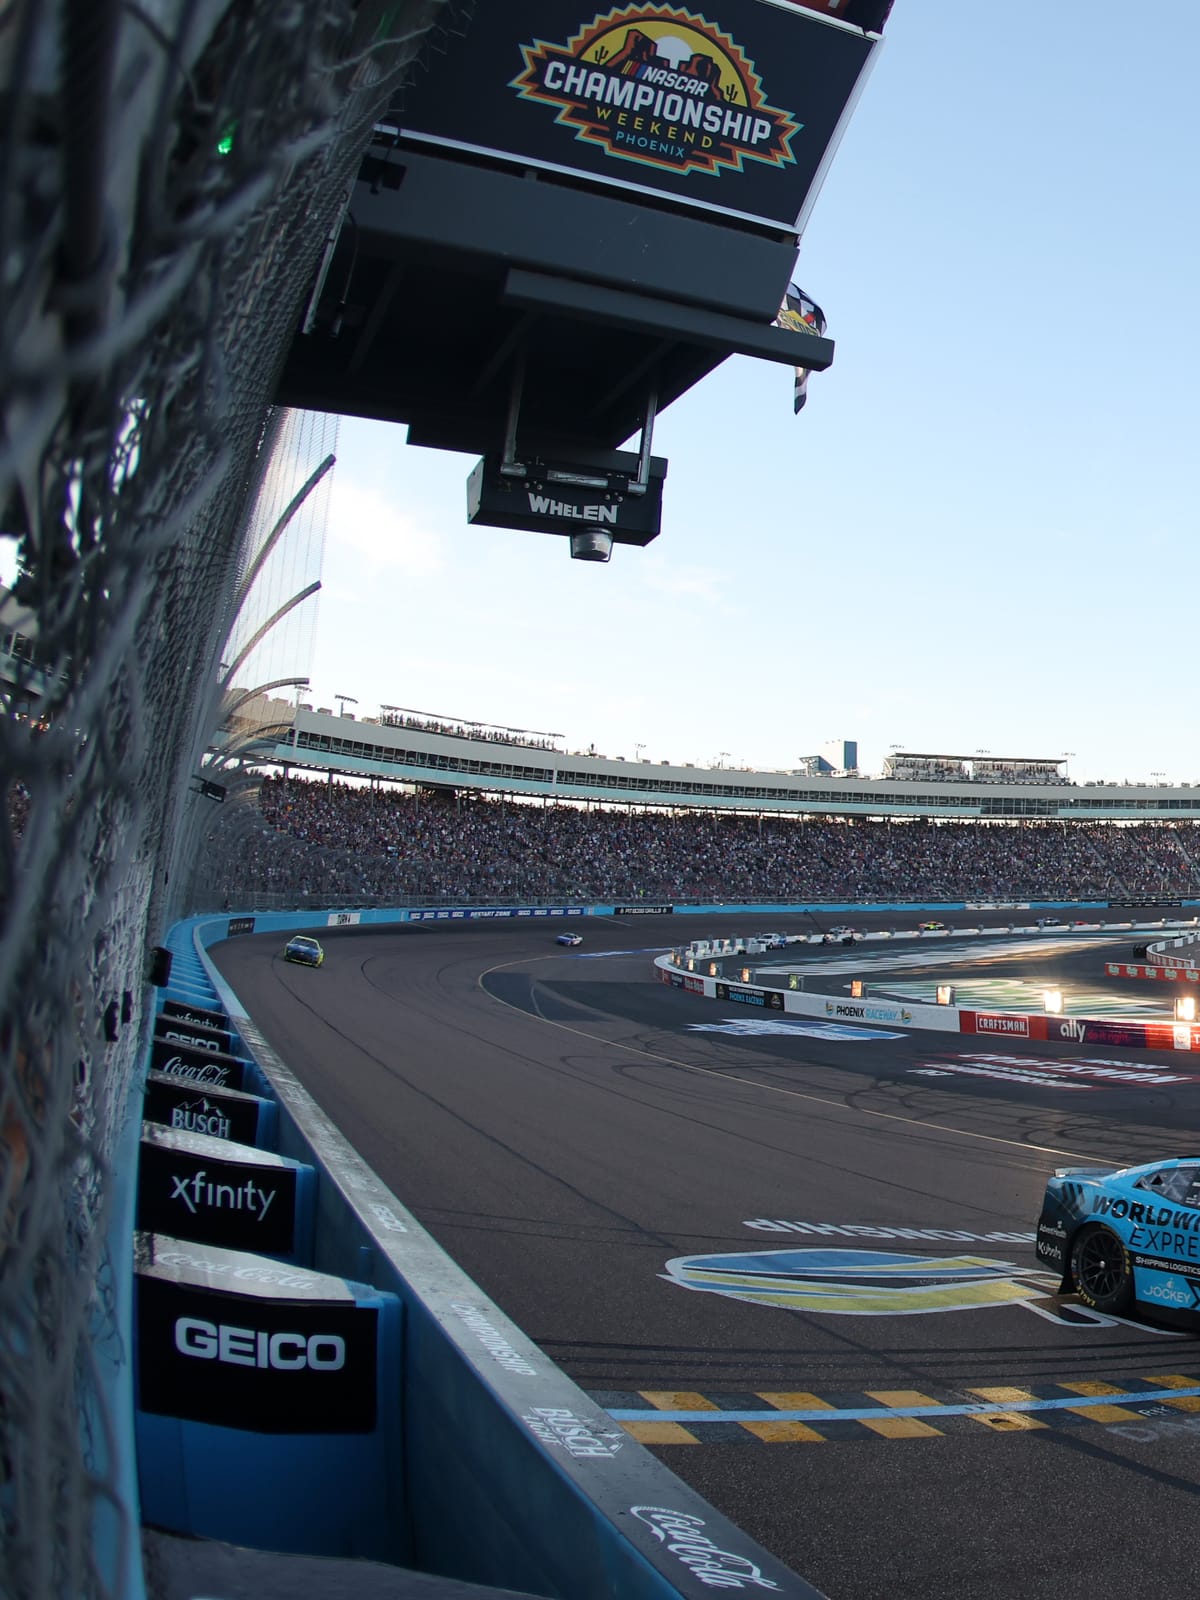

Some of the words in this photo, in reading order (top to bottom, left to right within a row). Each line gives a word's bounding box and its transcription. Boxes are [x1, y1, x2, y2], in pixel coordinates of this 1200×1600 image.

[642, 65, 709, 98] NASCAR
[543, 61, 771, 145] CHAMPIONSHIP
[595, 107, 713, 149] WEEKEND
[615, 130, 685, 158] PHOENIX
[528, 492, 619, 523] WHELEN
[836, 1005, 865, 1018] PHOENIX
[866, 1007, 898, 1022] RACEWAY
[978, 1017, 1027, 1032] CRAFTSMAN
[1060, 1020, 1086, 1043] ally
[171, 1108, 231, 1138] BUSCH
[171, 1171, 276, 1221] xfinity
[1135, 1256, 1169, 1269] SHIPPING
[1143, 1285, 1191, 1303] JOCKEY
[175, 1317, 346, 1371] GEICO
[450, 1301, 537, 1377] CHAMPIONSHIP
[521, 1414, 560, 1446] LIGHT
[529, 1407, 617, 1458] BUSCH
[630, 1505, 783, 1592] Coca-Cola
